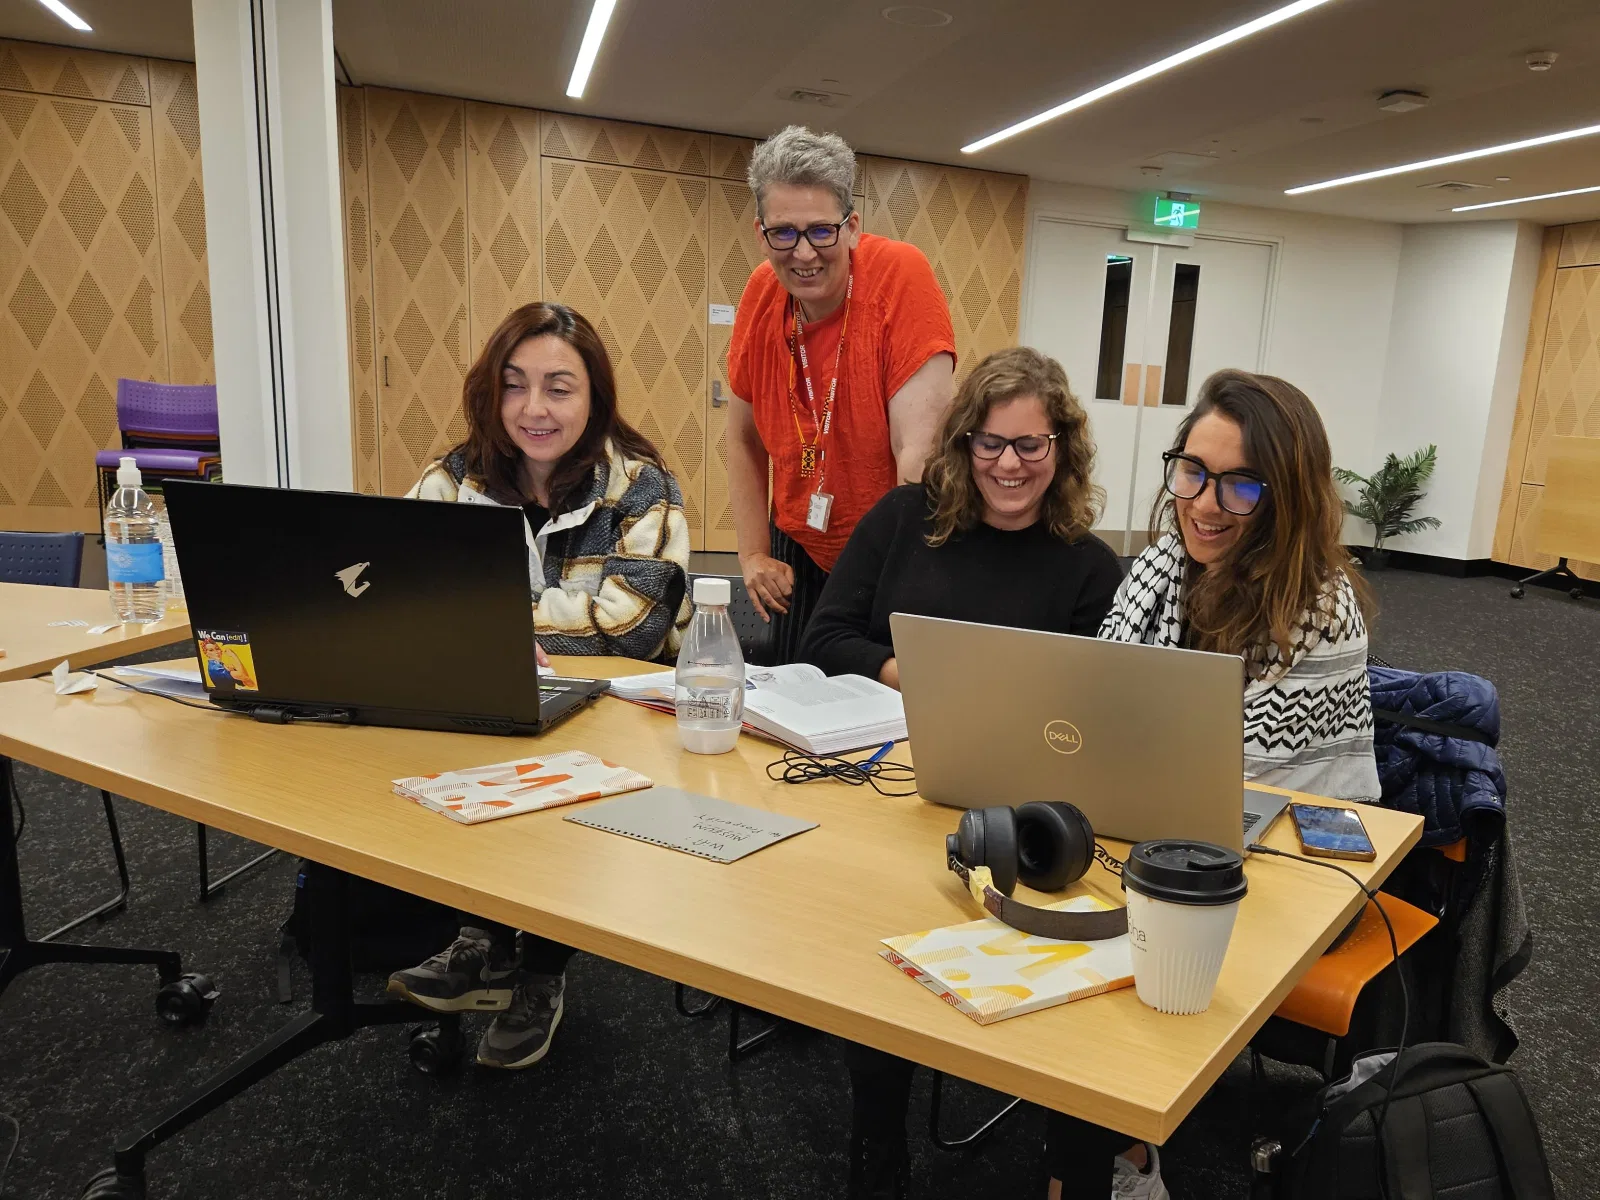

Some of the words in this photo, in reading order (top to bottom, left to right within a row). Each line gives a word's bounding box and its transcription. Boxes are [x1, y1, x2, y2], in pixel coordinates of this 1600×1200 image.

[800, 344, 808, 369] VISITOR
[806, 377, 814, 401] VISITOR
[829, 377, 837, 401] VISITOR
[823, 411, 832, 434] VISITOR
[198, 630, 211, 639] We
[211, 632, 226, 641] Can
[1049, 731, 1079, 744] DELL
[693, 822, 749, 841] MUSEUM
